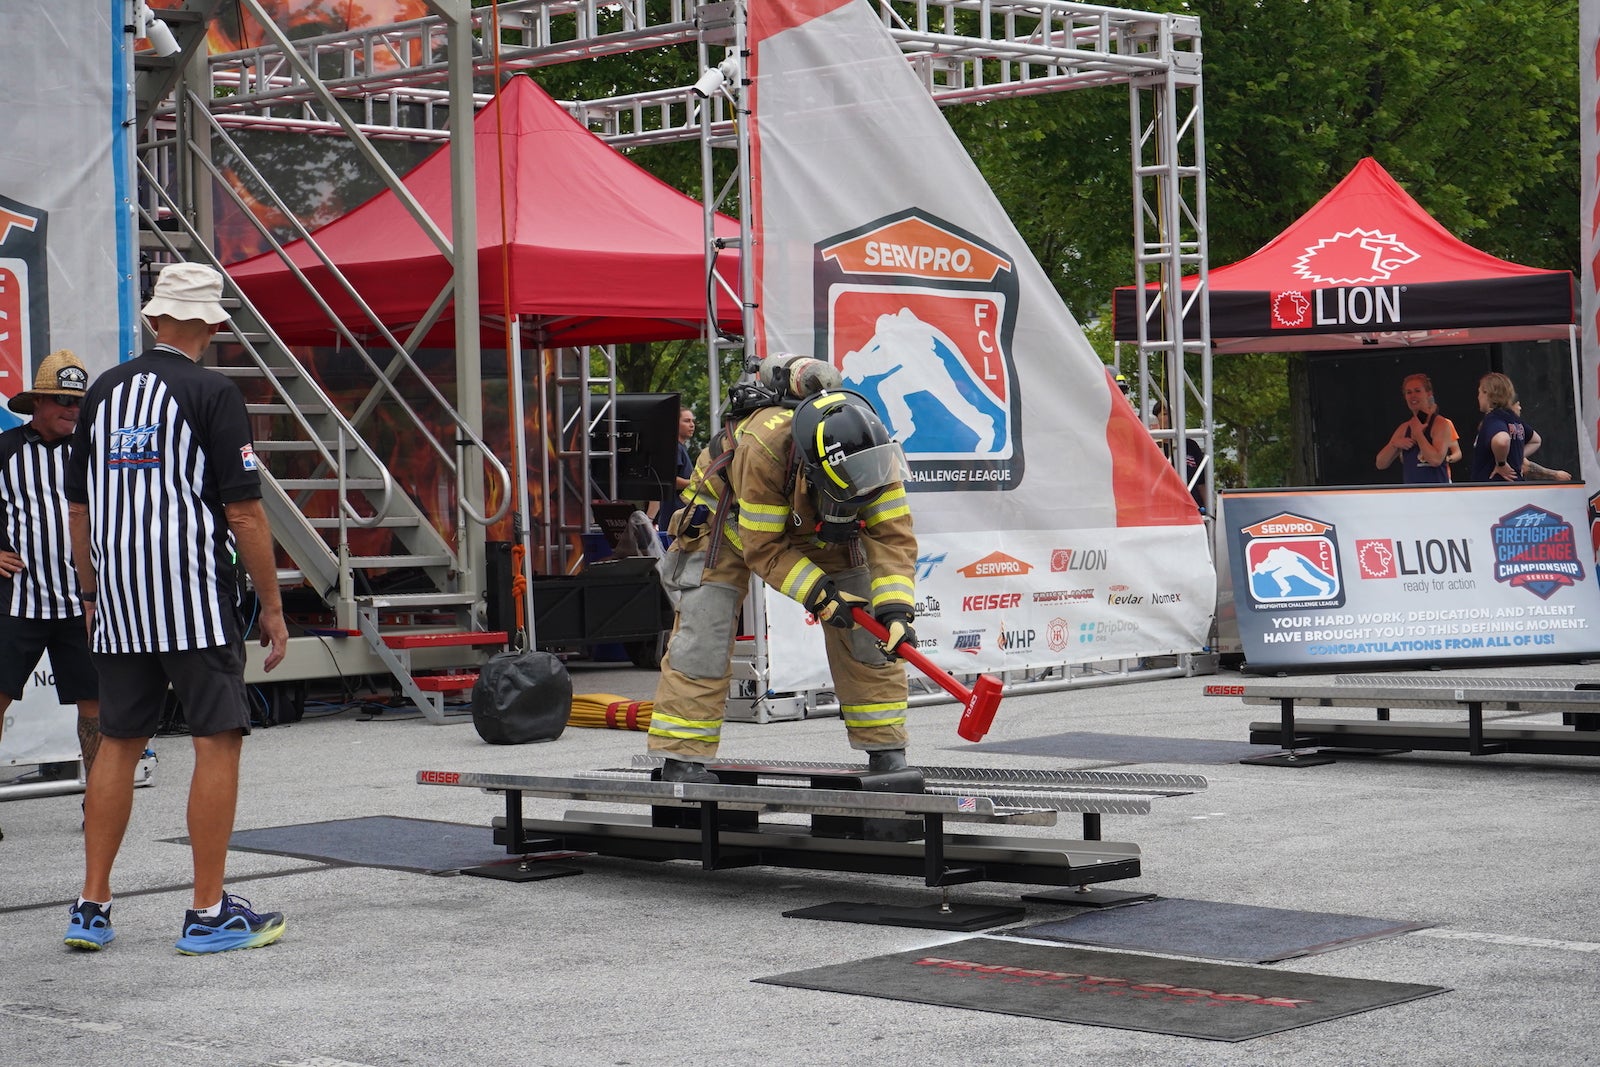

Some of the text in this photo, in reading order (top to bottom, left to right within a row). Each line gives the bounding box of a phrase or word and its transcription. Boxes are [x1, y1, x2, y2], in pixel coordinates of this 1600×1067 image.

[864, 242, 972, 273] SERVPRO
[1316, 286, 1400, 325] LION
[825, 442, 847, 467] 15
[969, 469, 1011, 481] LEAGUE
[1261, 523, 1314, 534] SERVPRO
[1495, 526, 1569, 544] FIREFIGHTER
[1069, 549, 1107, 571] LION
[1396, 539, 1472, 575] LION
[1498, 543, 1572, 562] CHALLENGE
[976, 562, 1019, 574] SERVPRO
[1499, 563, 1578, 577] CHAMPIONSHIP
[1403, 578, 1476, 593] ready for action
[962, 593, 1022, 611] KEISER
[1108, 594, 1143, 605] Kevlar
[1152, 593, 1181, 605] Nomex
[1272, 605, 1576, 628] YOUR HARD WORK, DEDICATION, AND TALENT
[1097, 619, 1140, 635] DripDrop
[1263, 618, 1588, 643] HAVE BROUGHT YOU TO THIS DEFINING MOMENT.
[916, 639, 937, 648] STICS
[1002, 630, 1036, 650] WHP
[1307, 634, 1555, 656] CONGRATULATIONS FROM ALL OF US!
[1207, 686, 1245, 695] KEISER
[422, 771, 460, 784] KEISER
